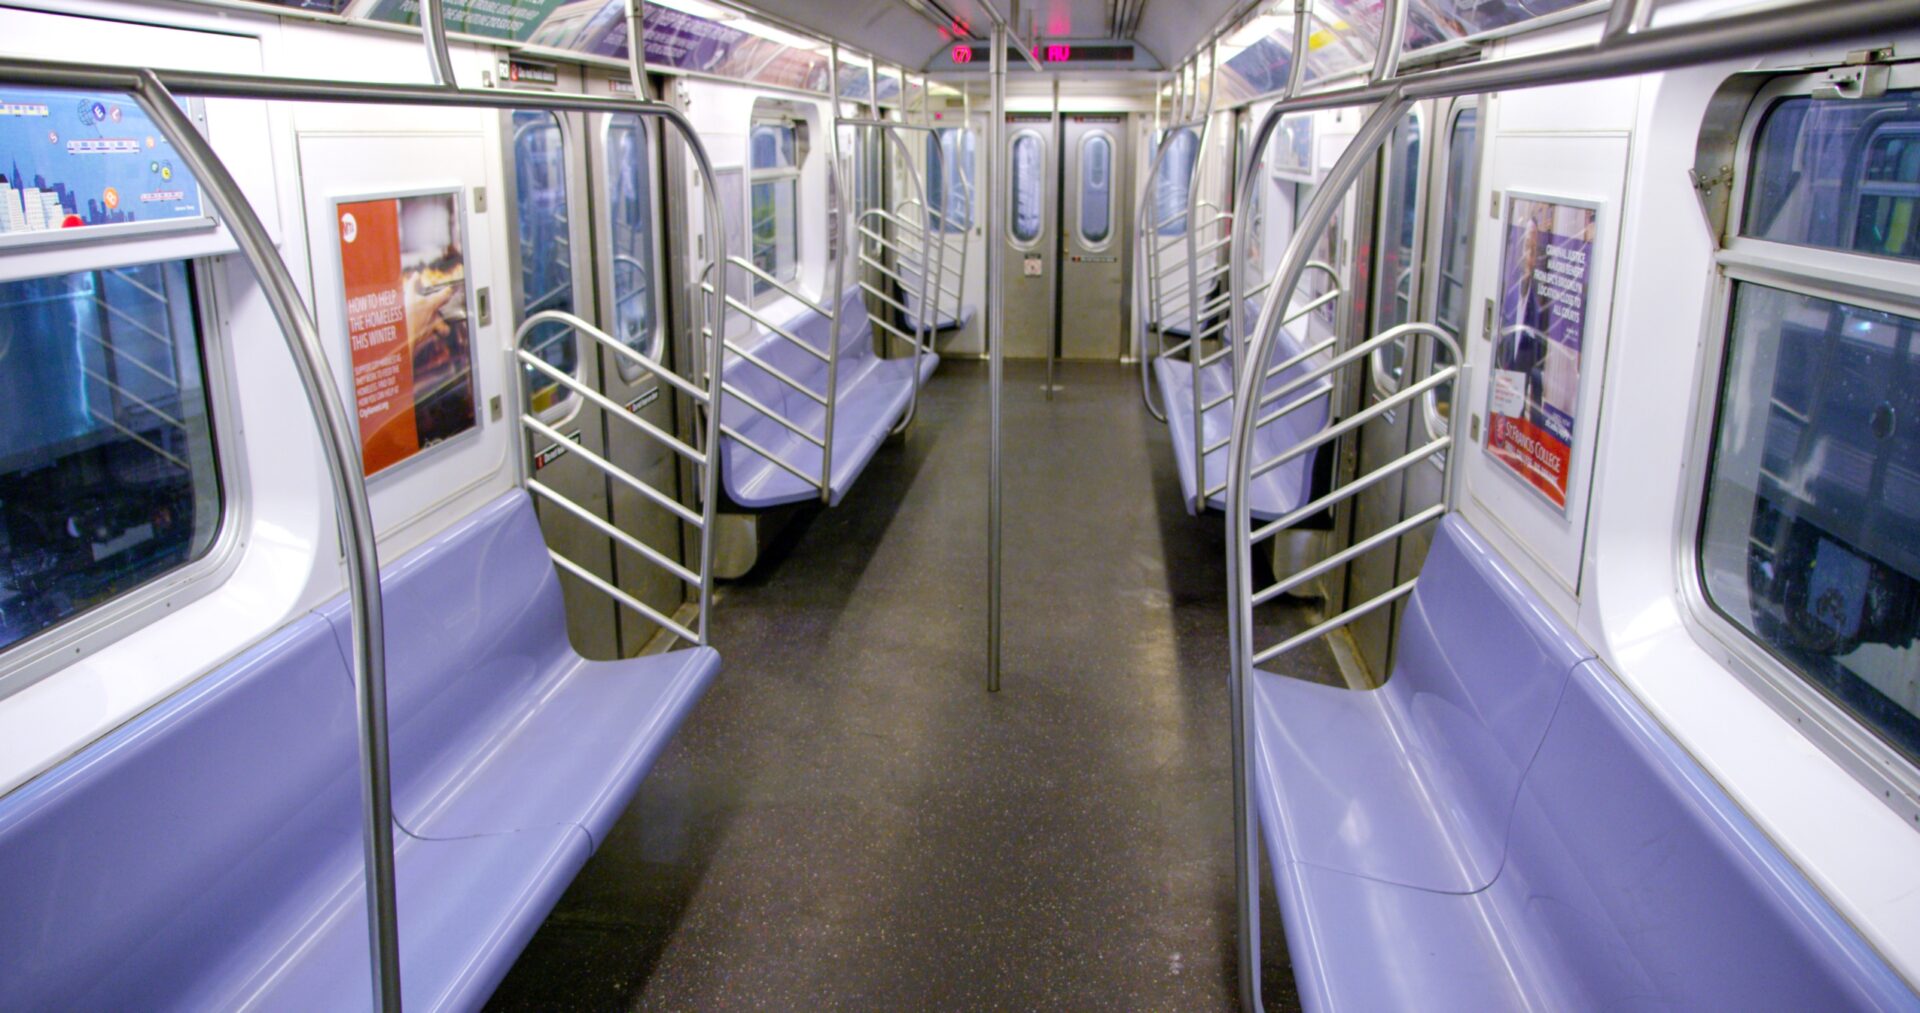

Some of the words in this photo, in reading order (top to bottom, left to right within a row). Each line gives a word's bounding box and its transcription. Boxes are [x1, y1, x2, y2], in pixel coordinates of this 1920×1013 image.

[348, 297, 367, 314] HOW
[367, 294, 378, 309] TO
[378, 289, 397, 306] HELP
[350, 315, 364, 331] THE
[365, 304, 403, 327] HOMELESS
[352, 333, 369, 350] THIS
[369, 325, 397, 346] WINTER
[1535, 441, 1561, 474] COLLEGE
